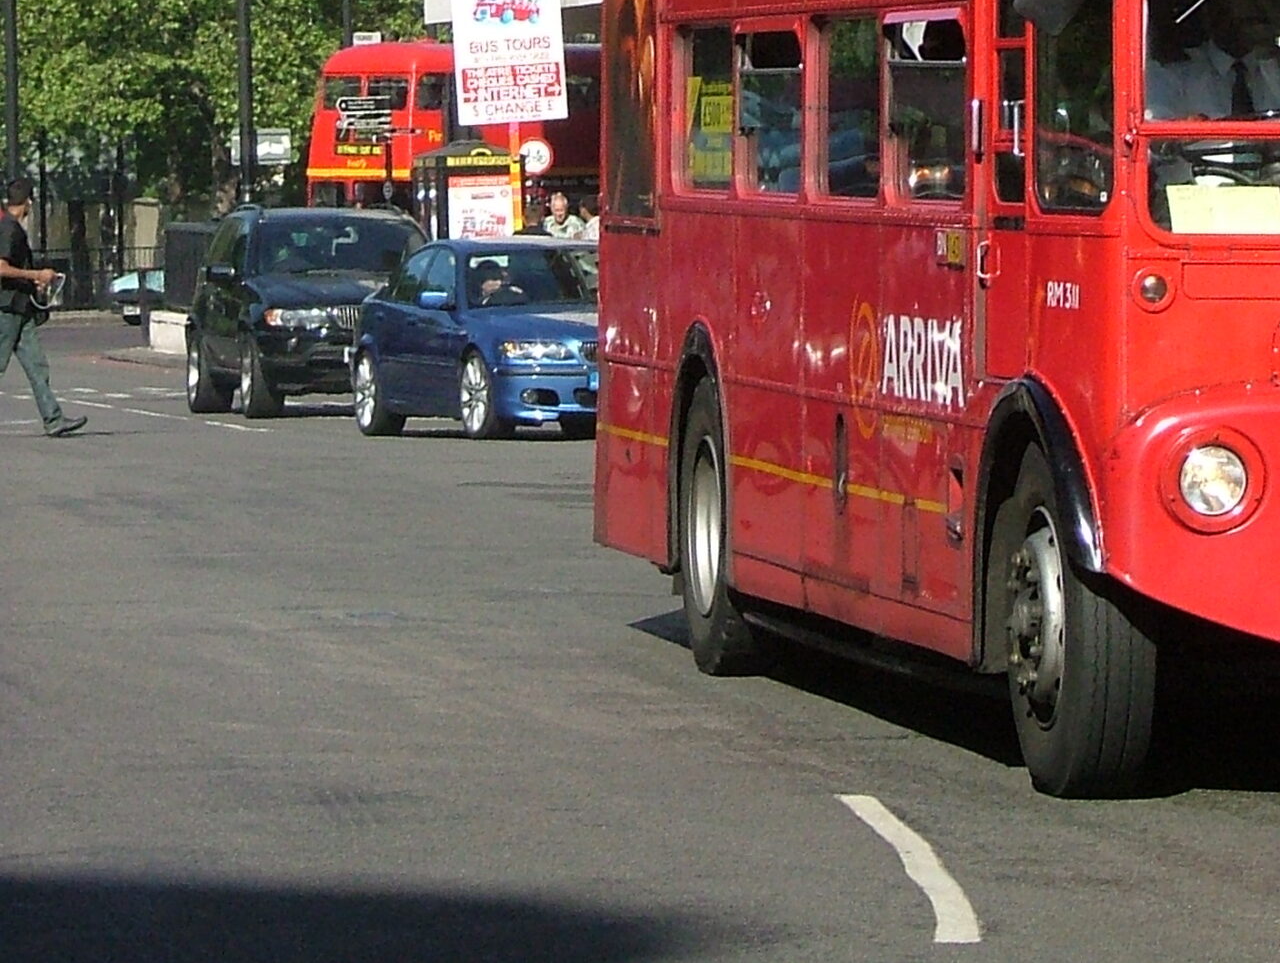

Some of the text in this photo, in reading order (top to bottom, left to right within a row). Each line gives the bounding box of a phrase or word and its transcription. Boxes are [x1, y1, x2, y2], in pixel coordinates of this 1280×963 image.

[469, 36, 551, 54] BUS TOURS
[485, 100, 543, 116] CHANGE
[881, 313, 966, 409] ARRIVA
